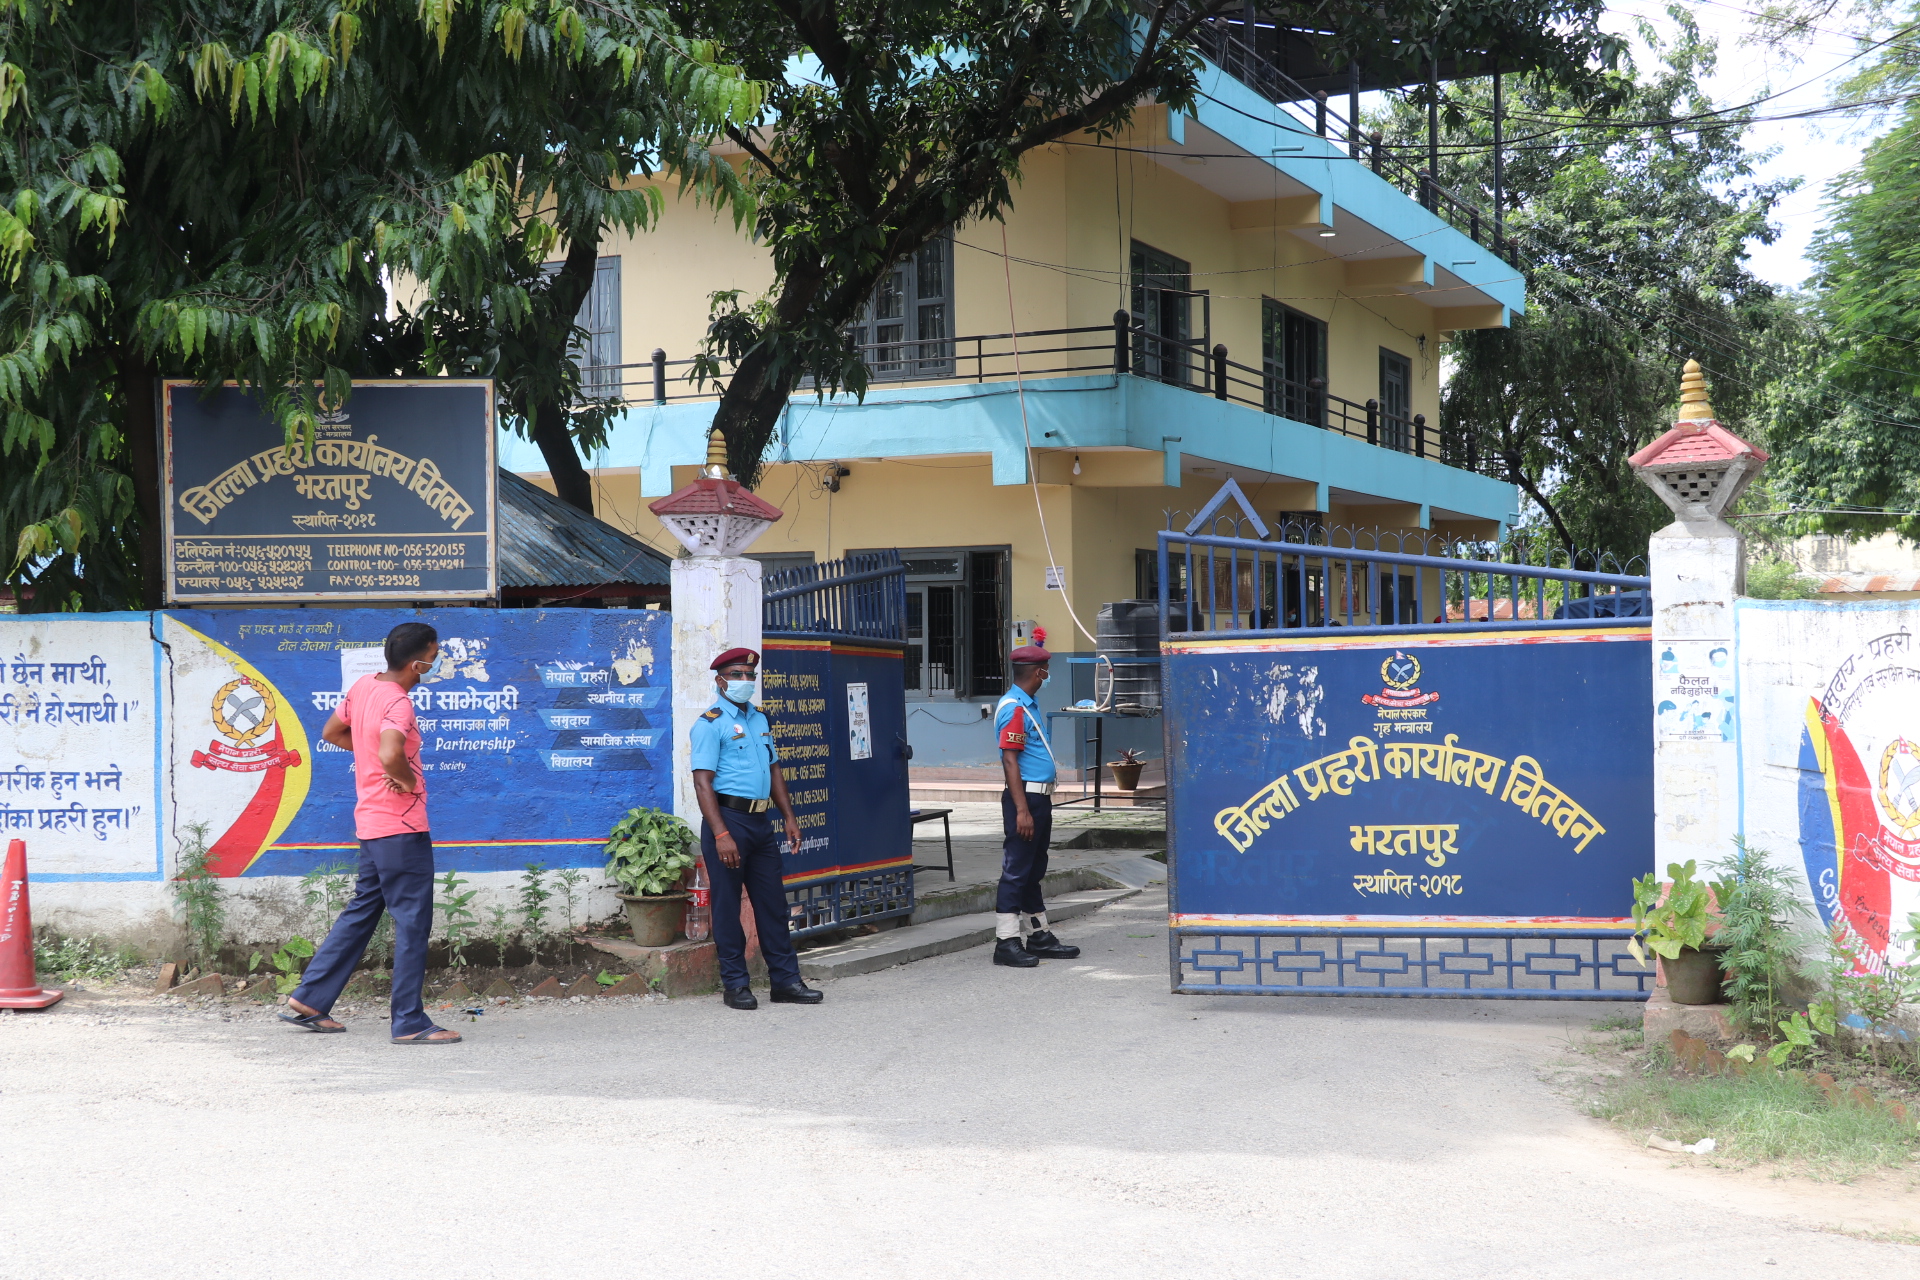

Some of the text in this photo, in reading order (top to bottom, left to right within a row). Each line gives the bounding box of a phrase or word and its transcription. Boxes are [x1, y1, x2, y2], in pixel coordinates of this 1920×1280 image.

[179, 459, 258, 525] जिल्ला
[316, 434, 416, 490] कार्यालय
[408, 457, 474, 531] चितवन
[293, 474, 372, 510] भरतपुर
[176, 541, 223, 559] टेलिफोन
[327, 544, 382, 557] TELEPHONE
[296, 625, 303, 634] र
[305, 622, 335, 635] नगरी
[278, 639, 299, 652] टोल
[300, 638, 333, 652] टोलमा
[1868, 625, 1912, 660] प्रहरी
[11, 652, 45, 688] छैन
[546, 669, 609, 685] नेपाल प्रहरी
[1679, 674, 1710, 686] फैलन
[436, 685, 519, 714] साझेदारी
[587, 691, 645, 705] स्थानीय तह
[45, 693, 65, 727] हो
[1377, 707, 1427, 720] नेपाल सरकार
[441, 718, 486, 732] समाजका
[488, 716, 510, 732] लागि
[550, 715, 592, 729] समुदाय
[1373, 722, 1433, 738] गृह मन्त्रालय
[436, 737, 516, 753] Partnership
[580, 733, 652, 747] सामाजिक संस्था
[440, 762, 466, 772] Society
[550, 753, 594, 768] विद्यालय
[50, 771, 80, 800] हुन
[85, 763, 122, 792] भने
[1214, 774, 1301, 854] जिल्ला
[1293, 735, 1381, 797] प्रहरी
[1384, 733, 1506, 797] कार्यालय
[1501, 754, 1606, 855] चितवन
[38, 802, 88, 834] प्रहरी
[1349, 824, 1460, 868] भरतपुर
[1884, 830, 1905, 853] नेपाल
[1895, 863, 1915, 880] सेवा
